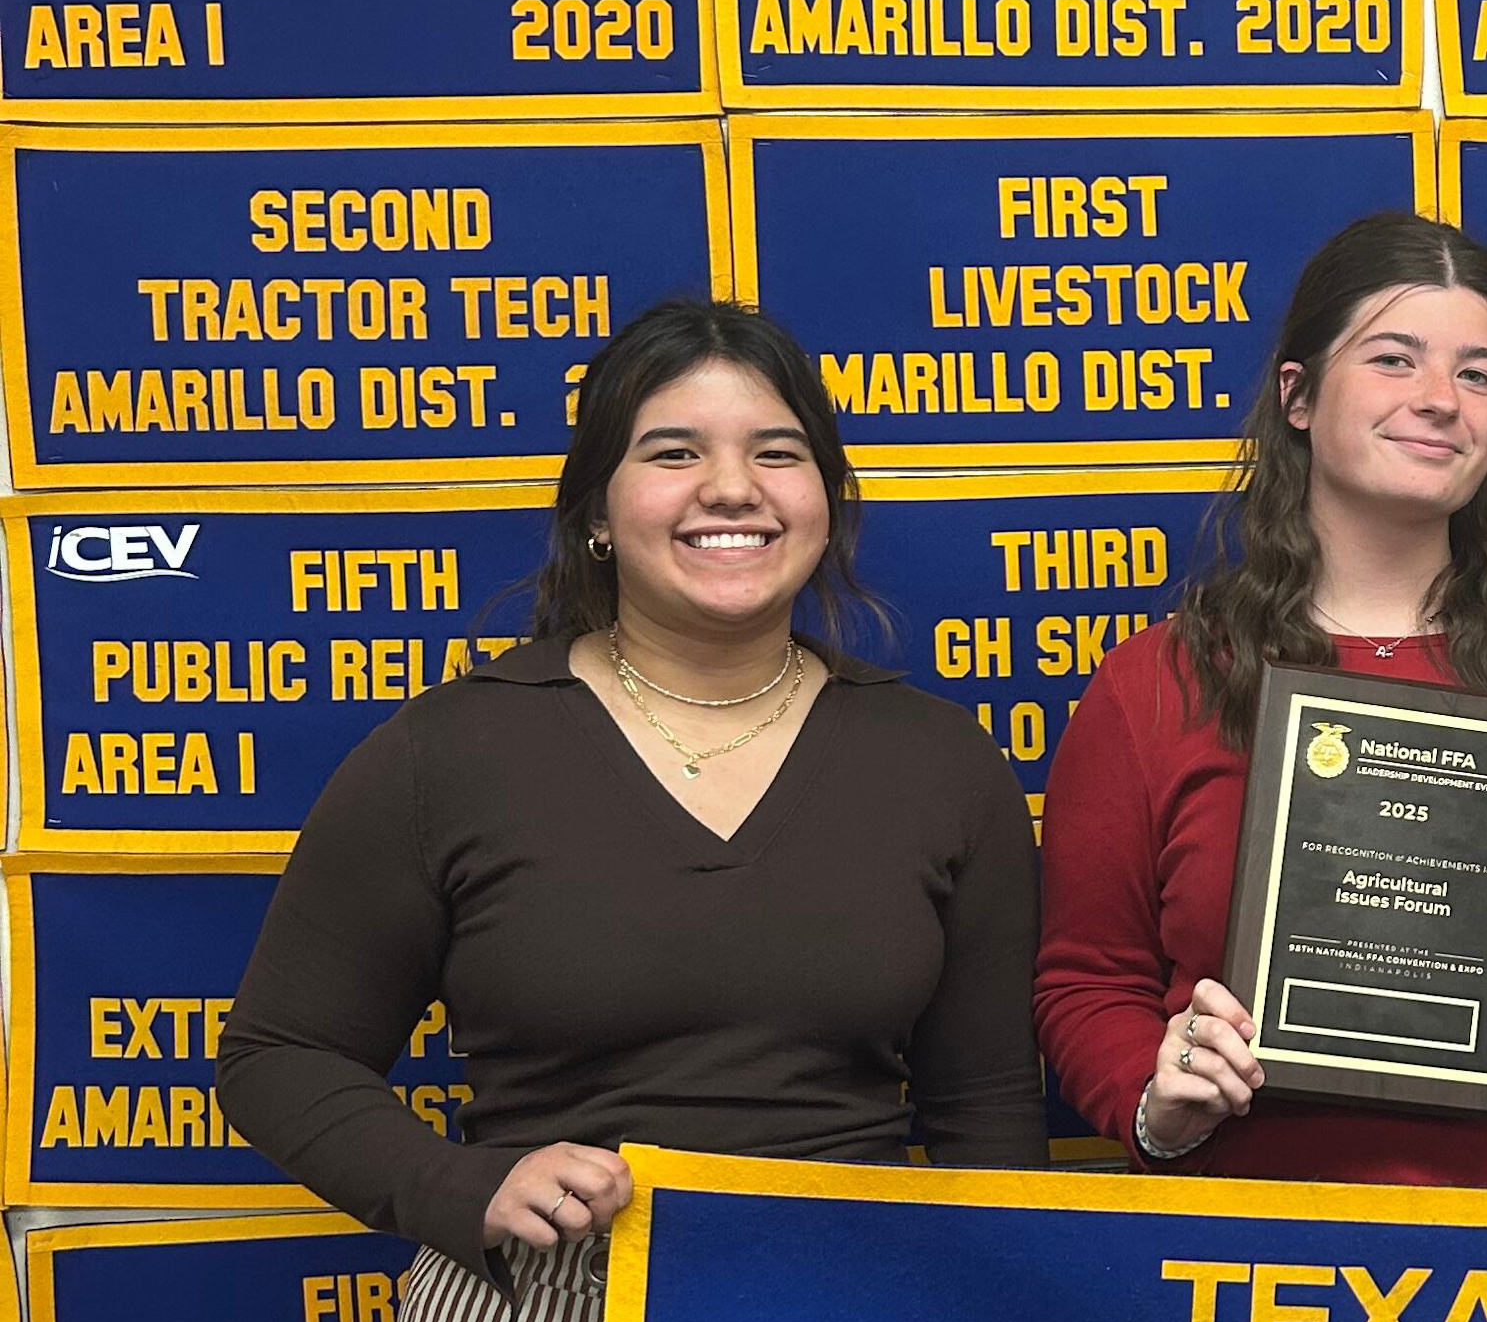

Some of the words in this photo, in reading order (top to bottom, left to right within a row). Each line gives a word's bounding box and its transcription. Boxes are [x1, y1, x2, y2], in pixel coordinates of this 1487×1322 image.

[24, 4, 185, 69] AREA
[206, 3, 224, 65] I
[250, 188, 491, 252] SECOND
[998, 176, 1167, 238] FIRST
[138, 279, 427, 341] TRACTOR
[451, 276, 610, 339] TECH
[930, 262, 1249, 327] LIVESTOCK
[50, 368, 335, 433] AMARILLO
[360, 366, 515, 429] DIST.
[1083, 349, 1230, 411] DIST.
[46, 523, 201, 573] iCEV
[991, 527, 1168, 591] THIRD
[290, 549, 459, 612] FIFTH
[93, 641, 306, 702] PUBLIC
[62, 733, 218, 794] AREA
[239, 733, 255, 793] I
[1356, 766, 1410, 780] LEADERSHIP
[1411, 772, 1474, 789] DEVELOPMENT
[1360, 739, 1437, 765] National
[1440, 750, 1476, 770] FFA
[1379, 801, 1429, 822] 2025
[1302, 842, 1323, 853] FOR
[1325, 845, 1393, 861] RECOGNITION
[1406, 855, 1480, 873] ACHIEVEMENTS
[1341, 870, 1447, 898] Agricultural
[1335, 887, 1391, 908] Issues
[1394, 895, 1450, 916] Forum
[1316, 946, 1364, 960] NATIONAL
[1366, 953, 1384, 962] FFA
[1386, 954, 1448, 969] CONVENTION
[1458, 965, 1483, 974] EXPO
